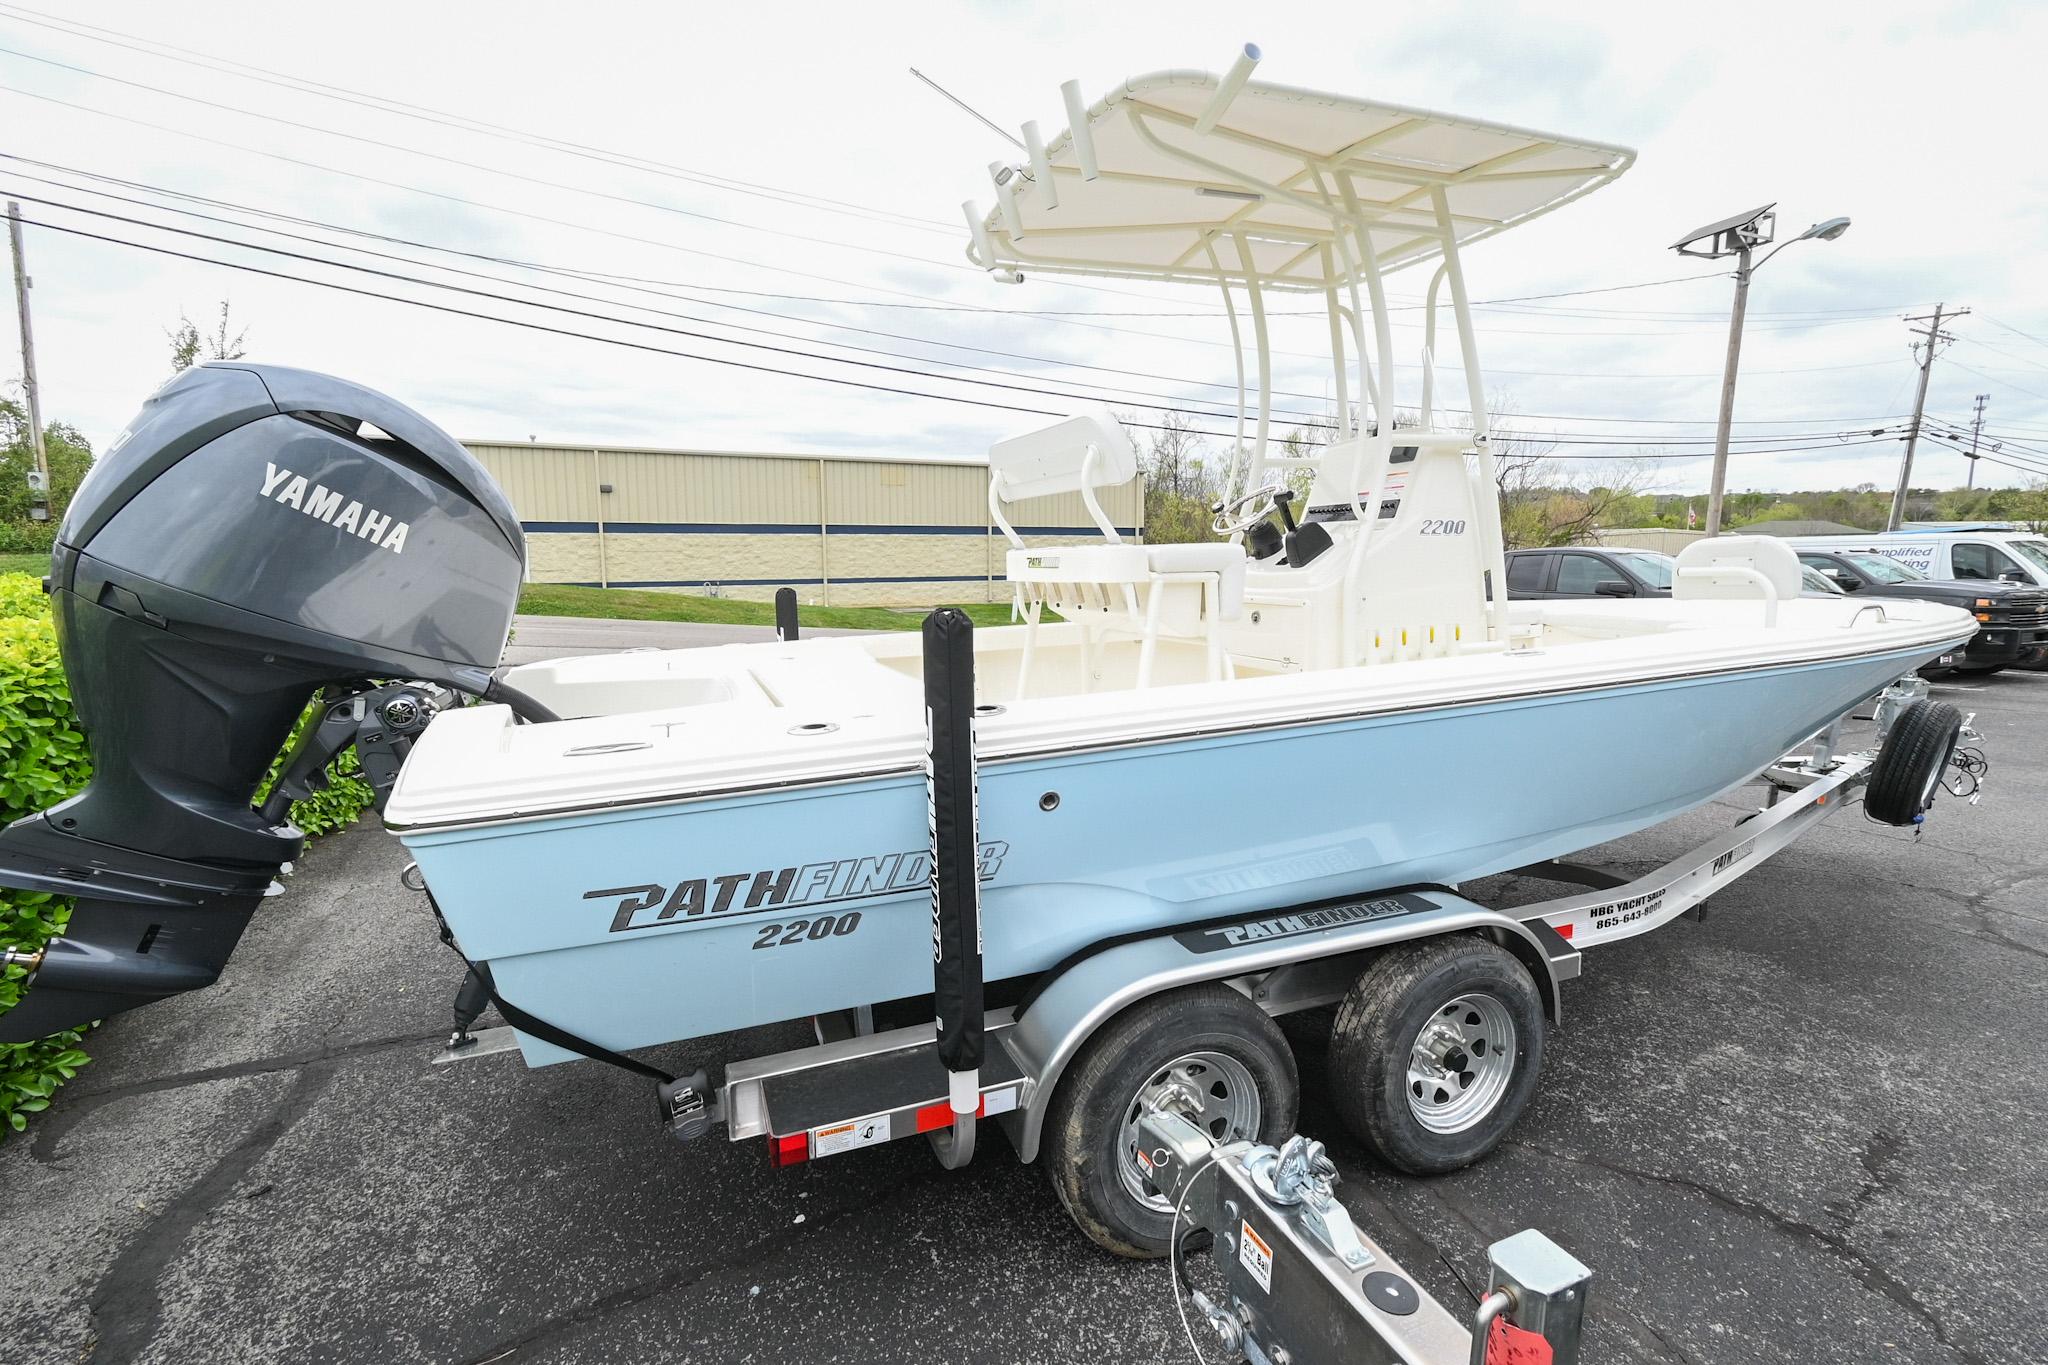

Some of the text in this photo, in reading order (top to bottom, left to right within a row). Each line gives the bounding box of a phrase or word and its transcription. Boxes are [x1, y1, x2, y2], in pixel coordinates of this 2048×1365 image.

[259, 461, 410, 554] YAMAHA
[1419, 519, 1466, 535] 2200
[582, 840, 1010, 934] PATHFINDR
[1590, 888, 1666, 918] HBG YACHT SALES
[752, 911, 863, 950] 2200
[1204, 899, 1410, 946] PATHFINDER
[1596, 900, 1662, 930] 865-643-8000
